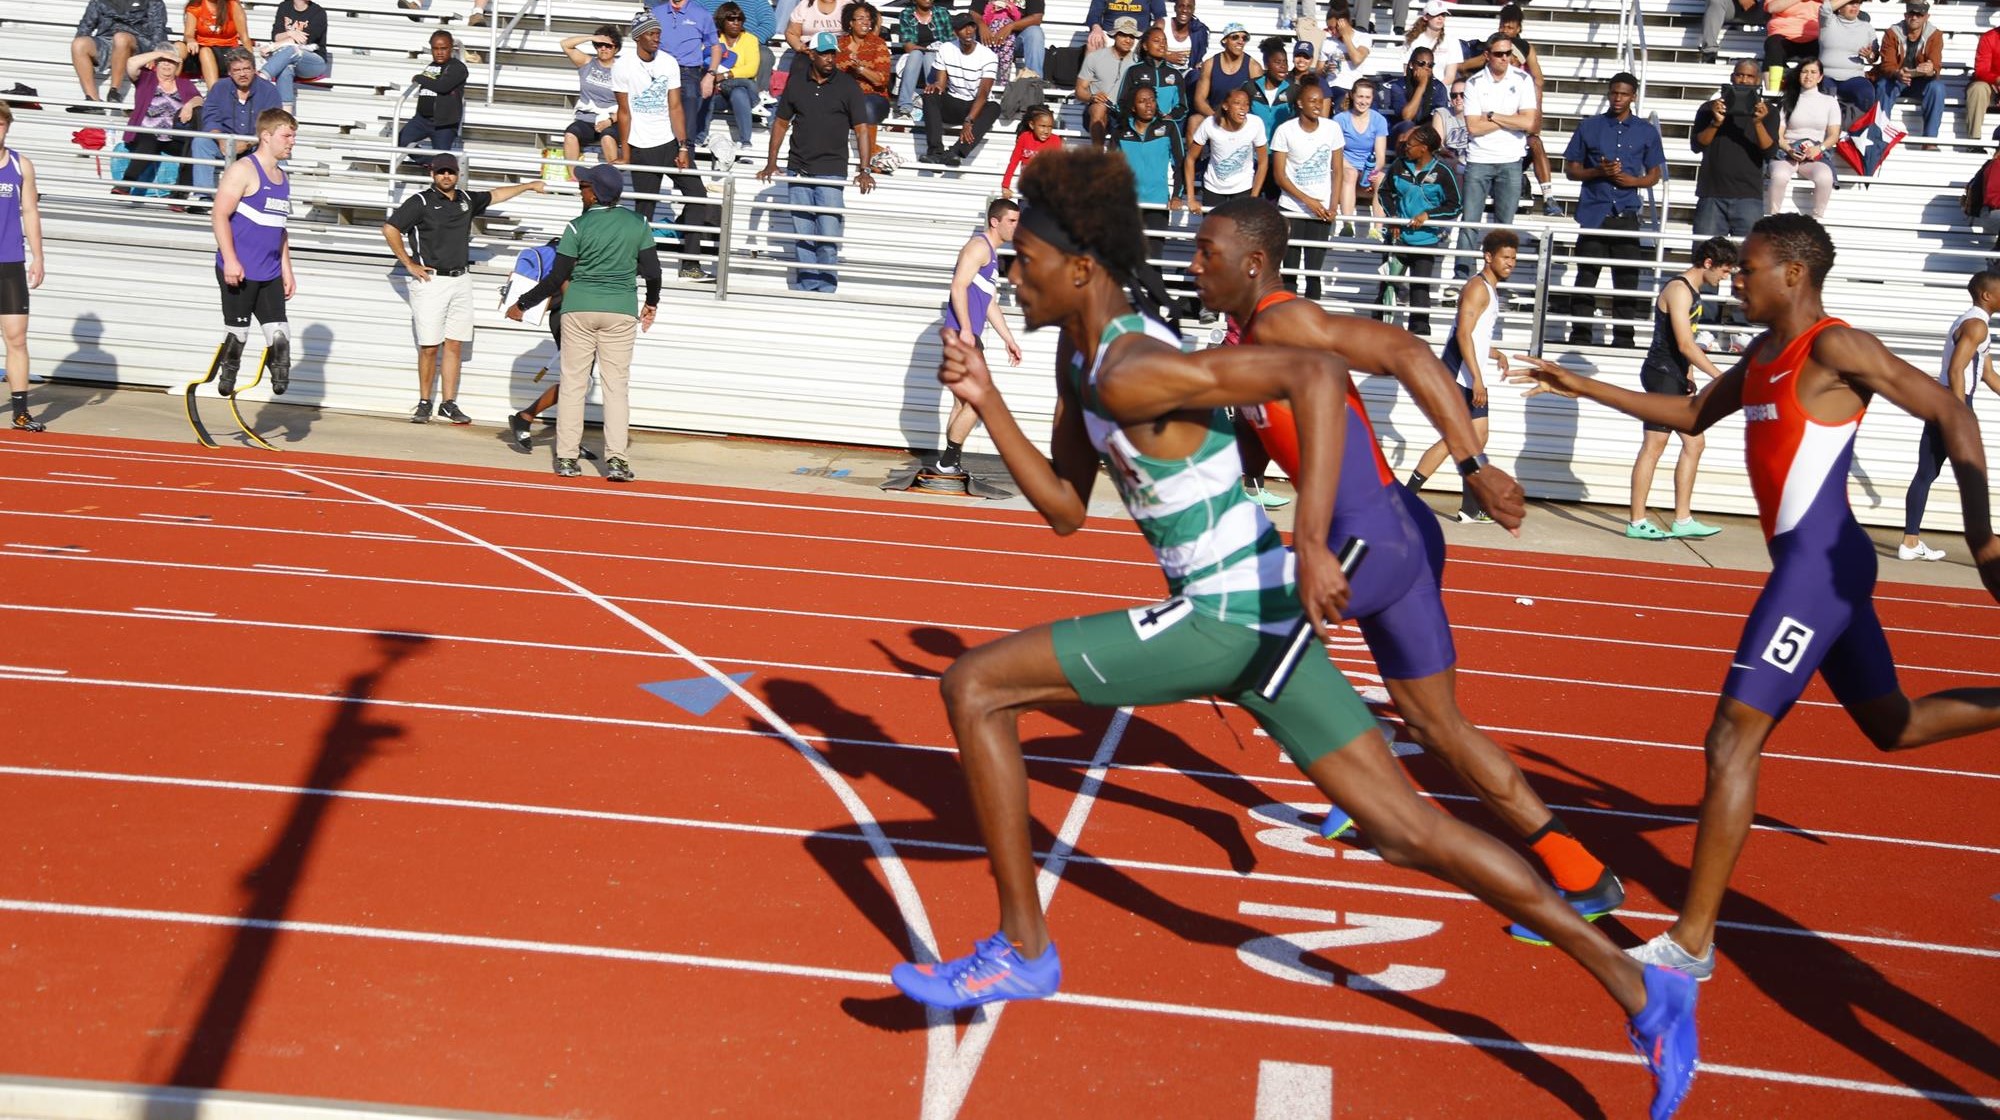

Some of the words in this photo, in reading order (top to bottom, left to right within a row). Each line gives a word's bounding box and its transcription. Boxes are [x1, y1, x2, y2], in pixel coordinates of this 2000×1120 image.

[813, 19, 842, 29] PARIS
[1772, 624, 1807, 665] 5
[1236, 900, 1446, 992] 2
